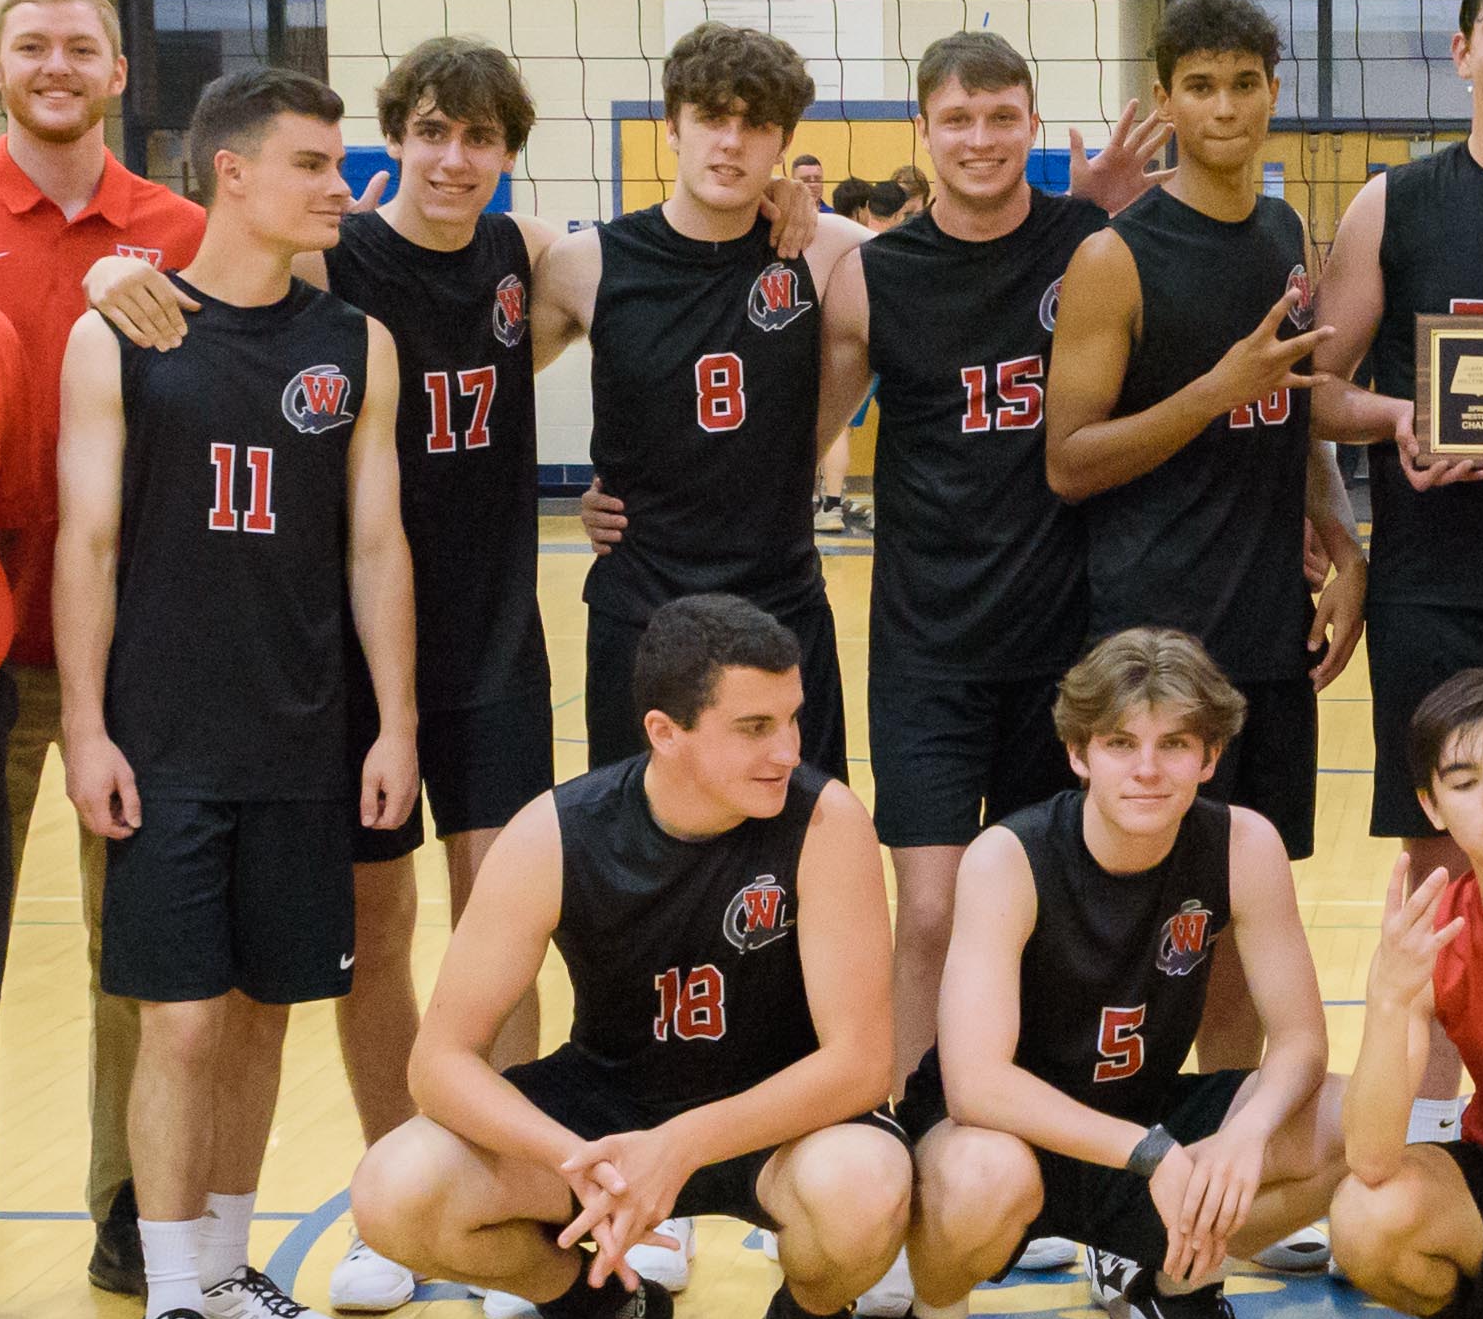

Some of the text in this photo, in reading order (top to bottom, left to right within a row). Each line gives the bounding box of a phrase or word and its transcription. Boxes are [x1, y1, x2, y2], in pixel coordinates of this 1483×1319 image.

[424, 365, 497, 454] 17
[695, 352, 746, 433] 8
[961, 355, 1045, 434] 15
[209, 442, 275, 535] 11
[653, 964, 727, 1041] 18
[1093, 1003, 1147, 1083] 5
